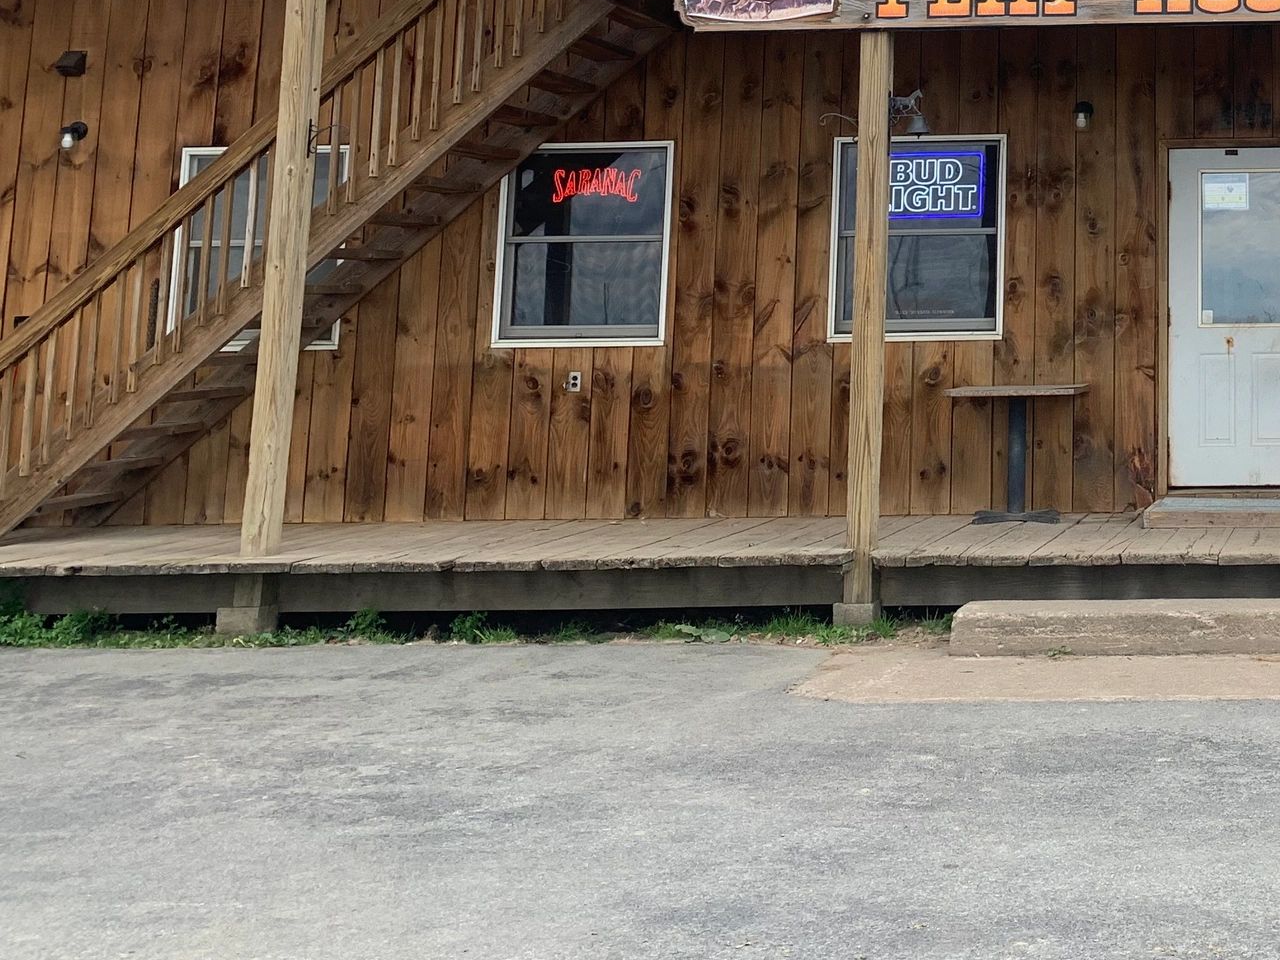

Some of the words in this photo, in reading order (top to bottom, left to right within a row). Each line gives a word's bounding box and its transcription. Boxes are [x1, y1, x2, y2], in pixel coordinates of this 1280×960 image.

[552, 167, 642, 203] SARANAC
[889, 158, 963, 186] BUD
[888, 185, 977, 212] IGHT
